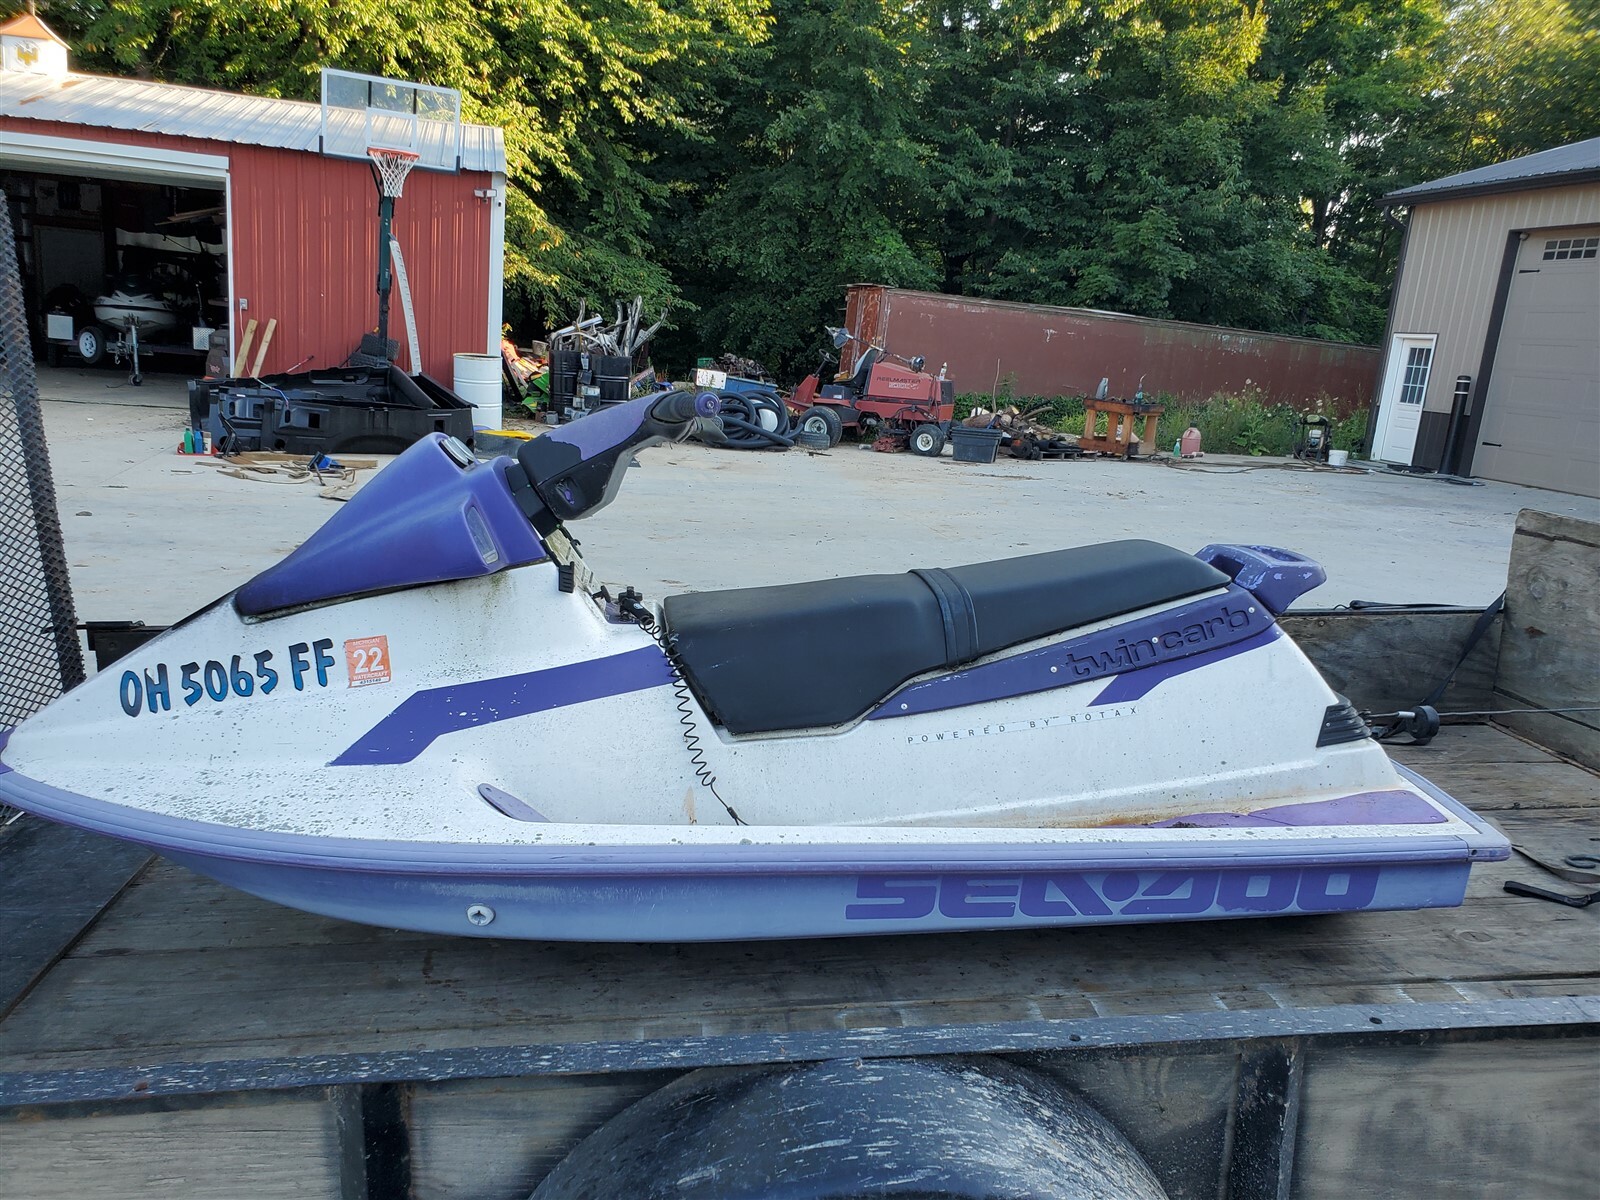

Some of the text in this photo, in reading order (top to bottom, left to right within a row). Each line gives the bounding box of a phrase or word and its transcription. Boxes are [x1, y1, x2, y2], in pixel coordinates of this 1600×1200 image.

[877, 376, 921, 384] REELMASTER
[1066, 606, 1250, 677] twin carb
[353, 647, 384, 674] 22
[353, 670, 389, 681] WATERCRAFT
[119, 638, 336, 718] OH 5065 FF
[907, 707, 1137, 744] POWERED BY ROTAX
